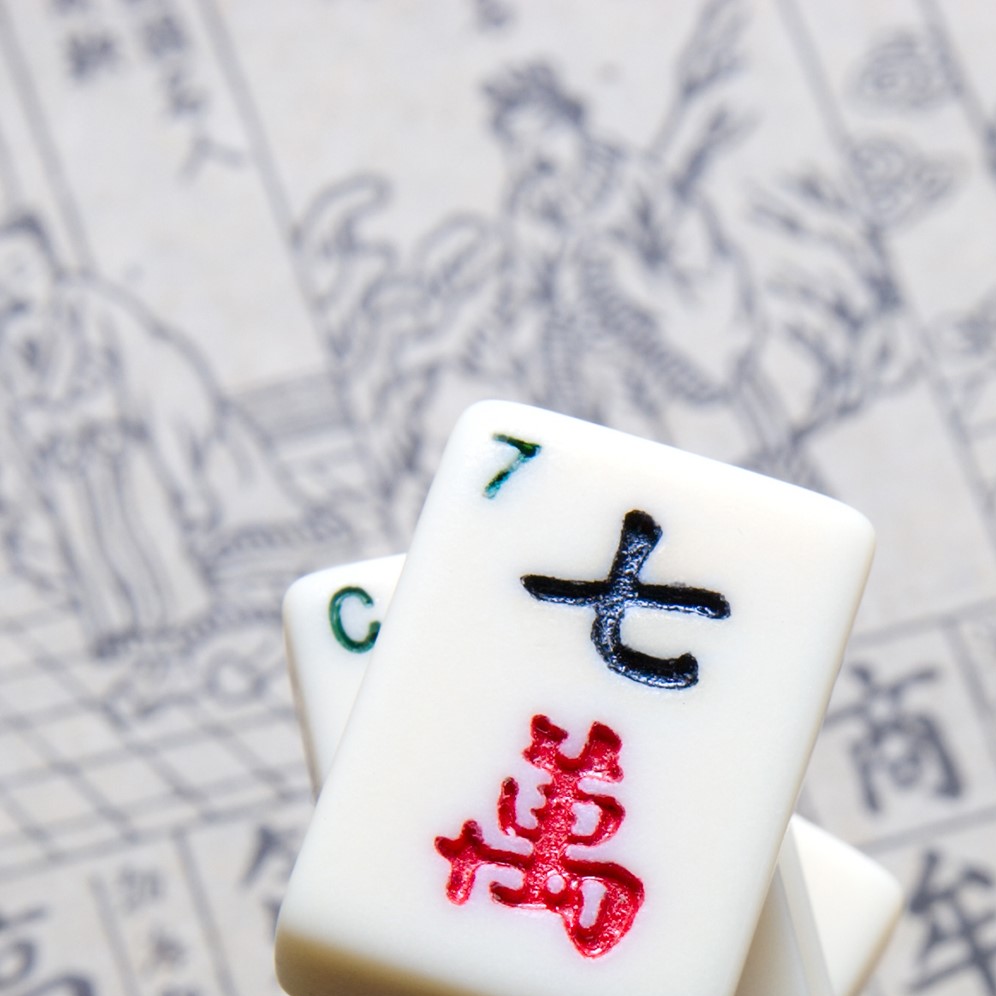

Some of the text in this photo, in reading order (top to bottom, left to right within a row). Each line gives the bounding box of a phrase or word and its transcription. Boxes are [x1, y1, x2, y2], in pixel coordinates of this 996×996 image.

[483, 432, 542, 499] 7
[327, 584, 382, 654] C
[820, 660, 963, 816] 商
